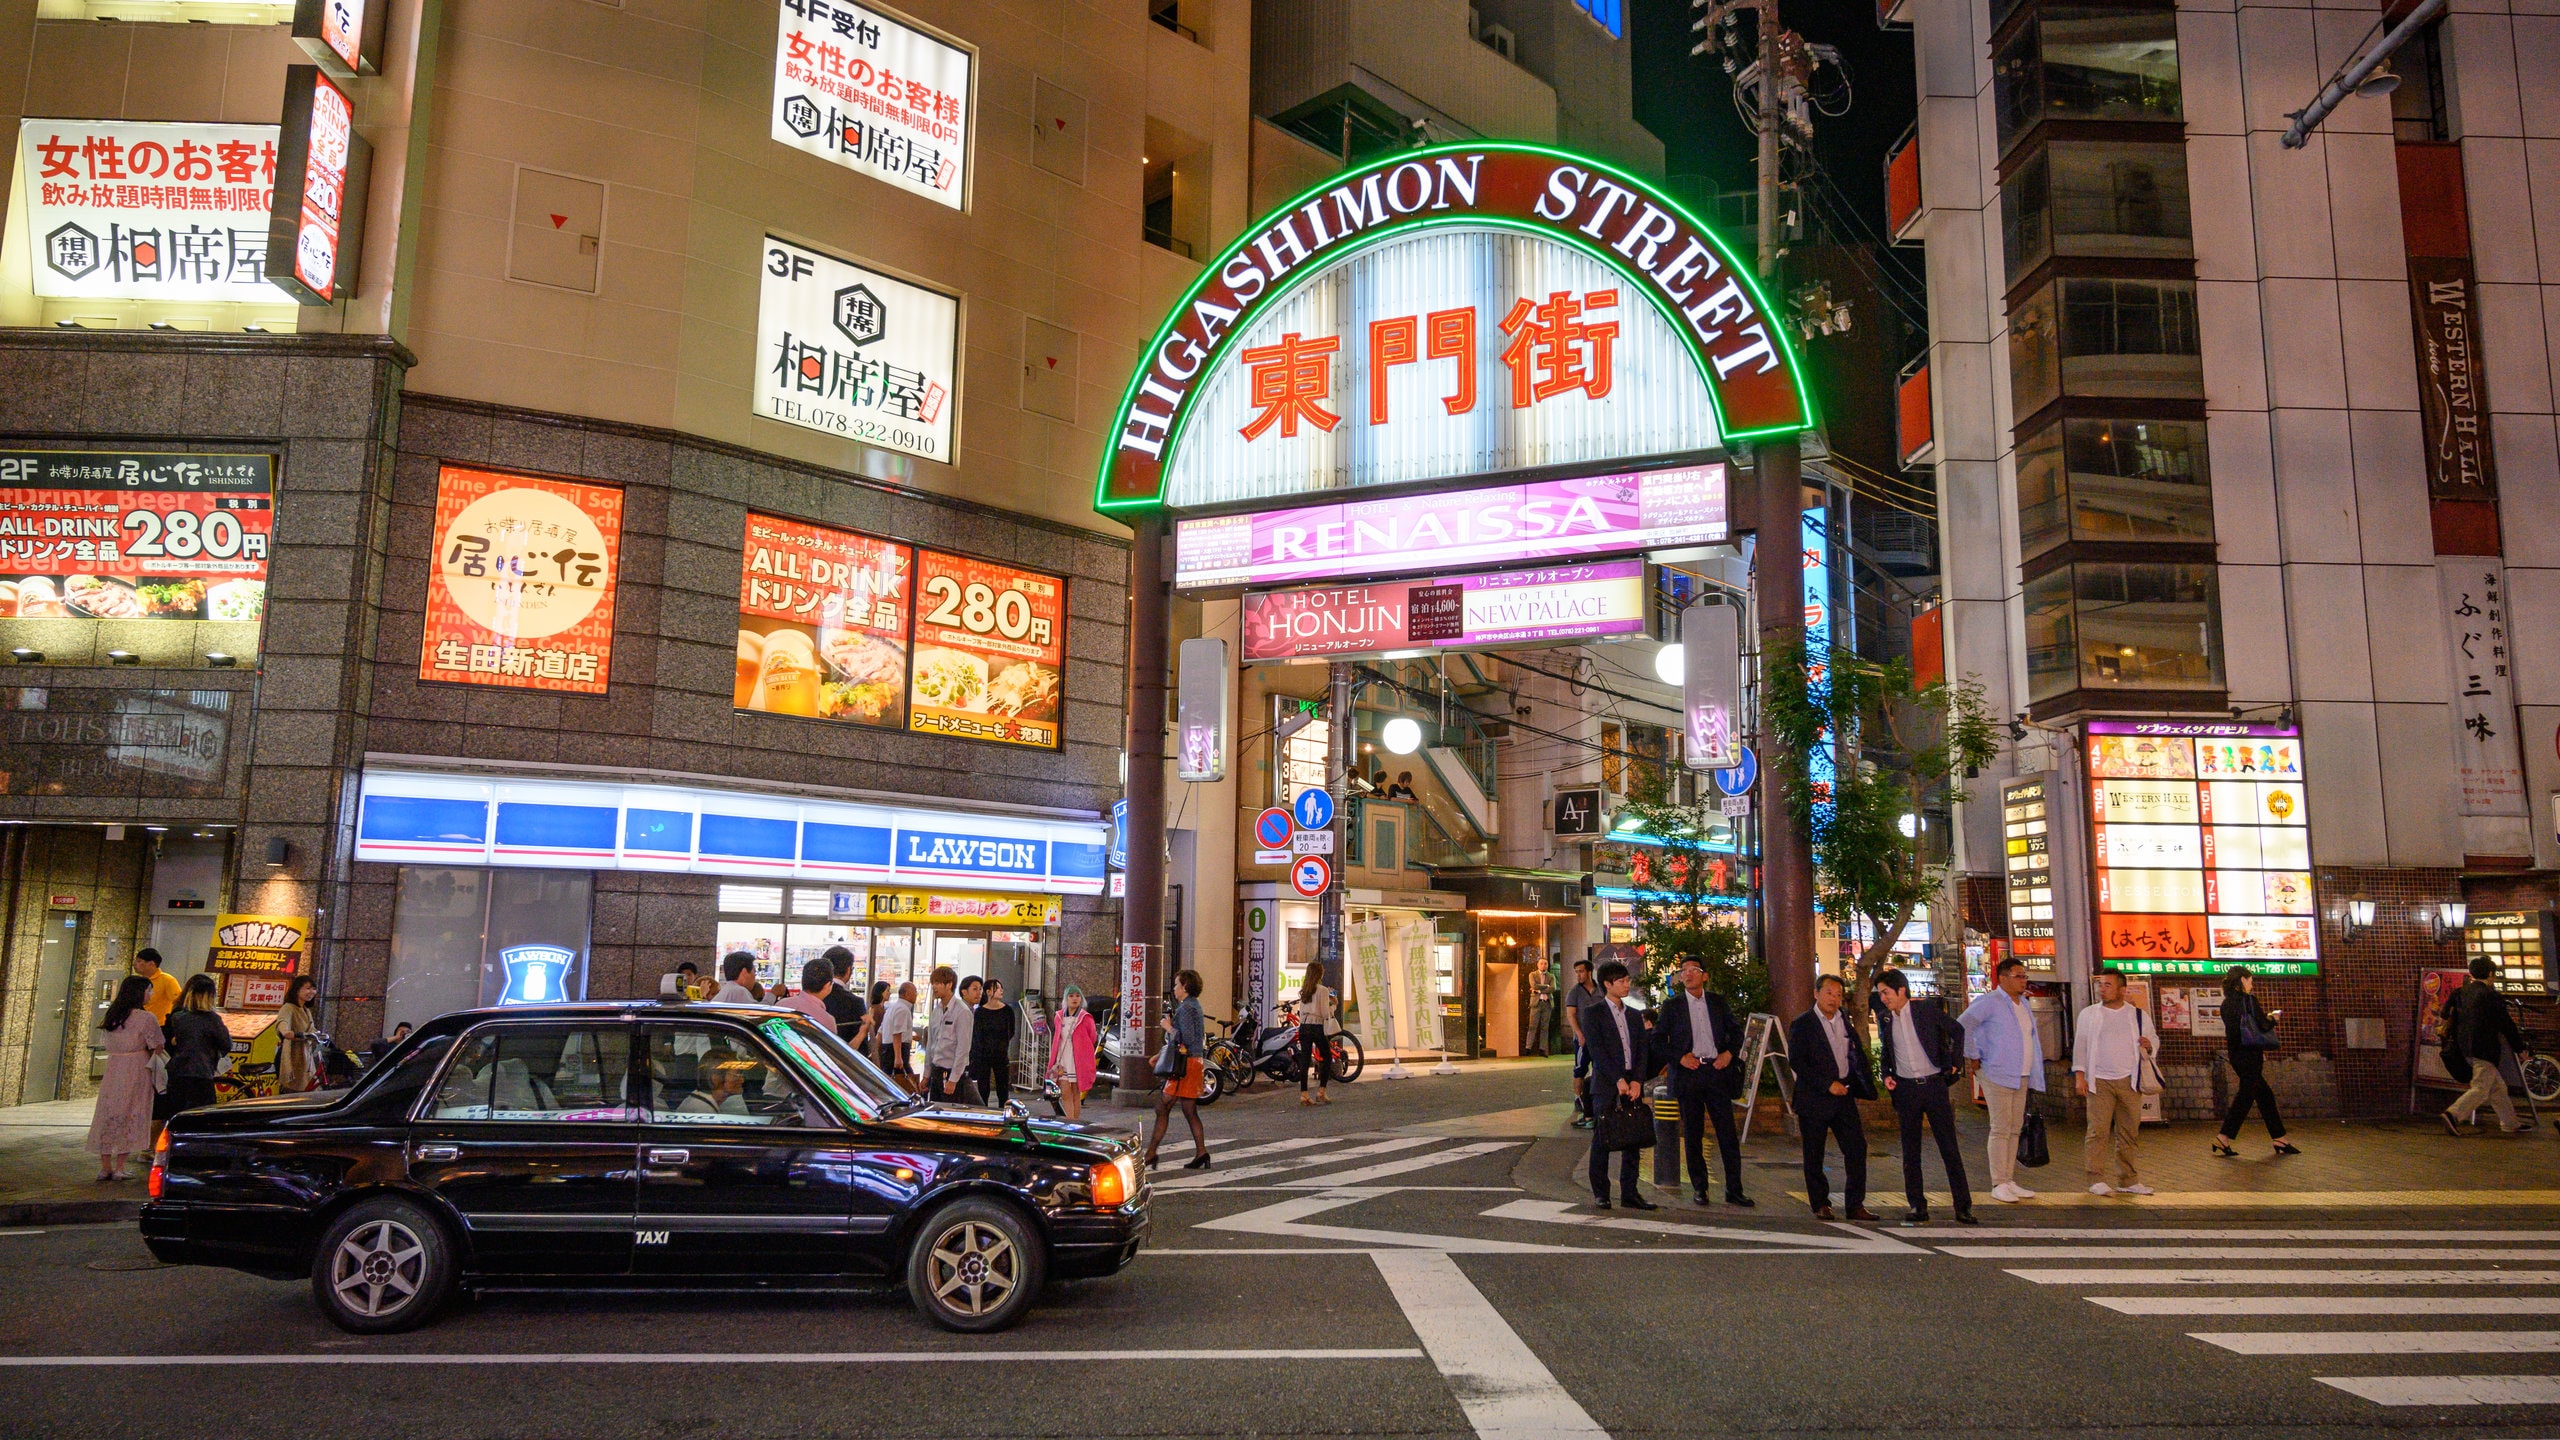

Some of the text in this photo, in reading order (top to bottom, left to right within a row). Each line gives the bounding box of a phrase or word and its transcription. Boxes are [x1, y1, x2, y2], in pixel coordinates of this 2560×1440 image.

[786, 30, 960, 126] 女性のお客様
[313, 96, 348, 139] DRINK
[322, 89, 343, 115] ALL
[785, 61, 958, 145] 飲み放題時間無制限0円
[823, 105, 941, 190] 相席屋
[767, 249, 814, 282] 3F
[1118, 155, 1779, 462] HIGASHIMON STREET
[772, 331, 926, 424] 相席屋
[1239, 289, 1619, 443] 東門街
[2429, 278, 2478, 485] WESTERN HALL
[771, 397, 936, 454] TEL.078-322-0910
[0, 458, 38, 481] 2F
[208, 477, 254, 486] ISHINDEN
[1351, 502, 1391, 516] HOTEL
[1464, 490, 1516, 505] Relaxing
[0, 517, 120, 538] ALL DRINK
[123, 509, 268, 560] 280円
[1273, 496, 1611, 561] RENAISSA
[1, 540, 119, 562] ドリンク全品
[448, 534, 602, 586] 居心伝
[749, 547, 905, 599] ALL DRINK
[1479, 567, 1595, 587] リニューアルオープン
[749, 577, 899, 632] ドリンク全品
[924, 575, 1052, 646] 280円
[1293, 589, 1376, 609] HOTEL
[1469, 596, 1608, 625] NEW PALACE
[1503, 588, 1569, 602] HOTEL
[1269, 604, 1401, 639] HONJIN
[2483, 572, 2508, 678] 海鮮創作料理
[1295, 638, 1375, 652] リニューアルオープン
[434, 641, 599, 683] 生田新道店
[2091, 745, 2101, 769] 4F
[2094, 789, 2104, 814] 3F
[2109, 792, 2191, 807] WESTERN HALL
[2201, 791, 2211, 815] 5F
[908, 836, 1036, 869] LAWSON
[2204, 835, 2214, 859] 6F
[905, 896, 921, 906] 国産
[2100, 878, 2109, 903] 1F
[2207, 880, 2216, 904] 7F
[905, 905, 926, 915] チキン
[1130, 945, 1144, 1031] 取締り強化中
[635, 1230, 670, 1244] TAXI
